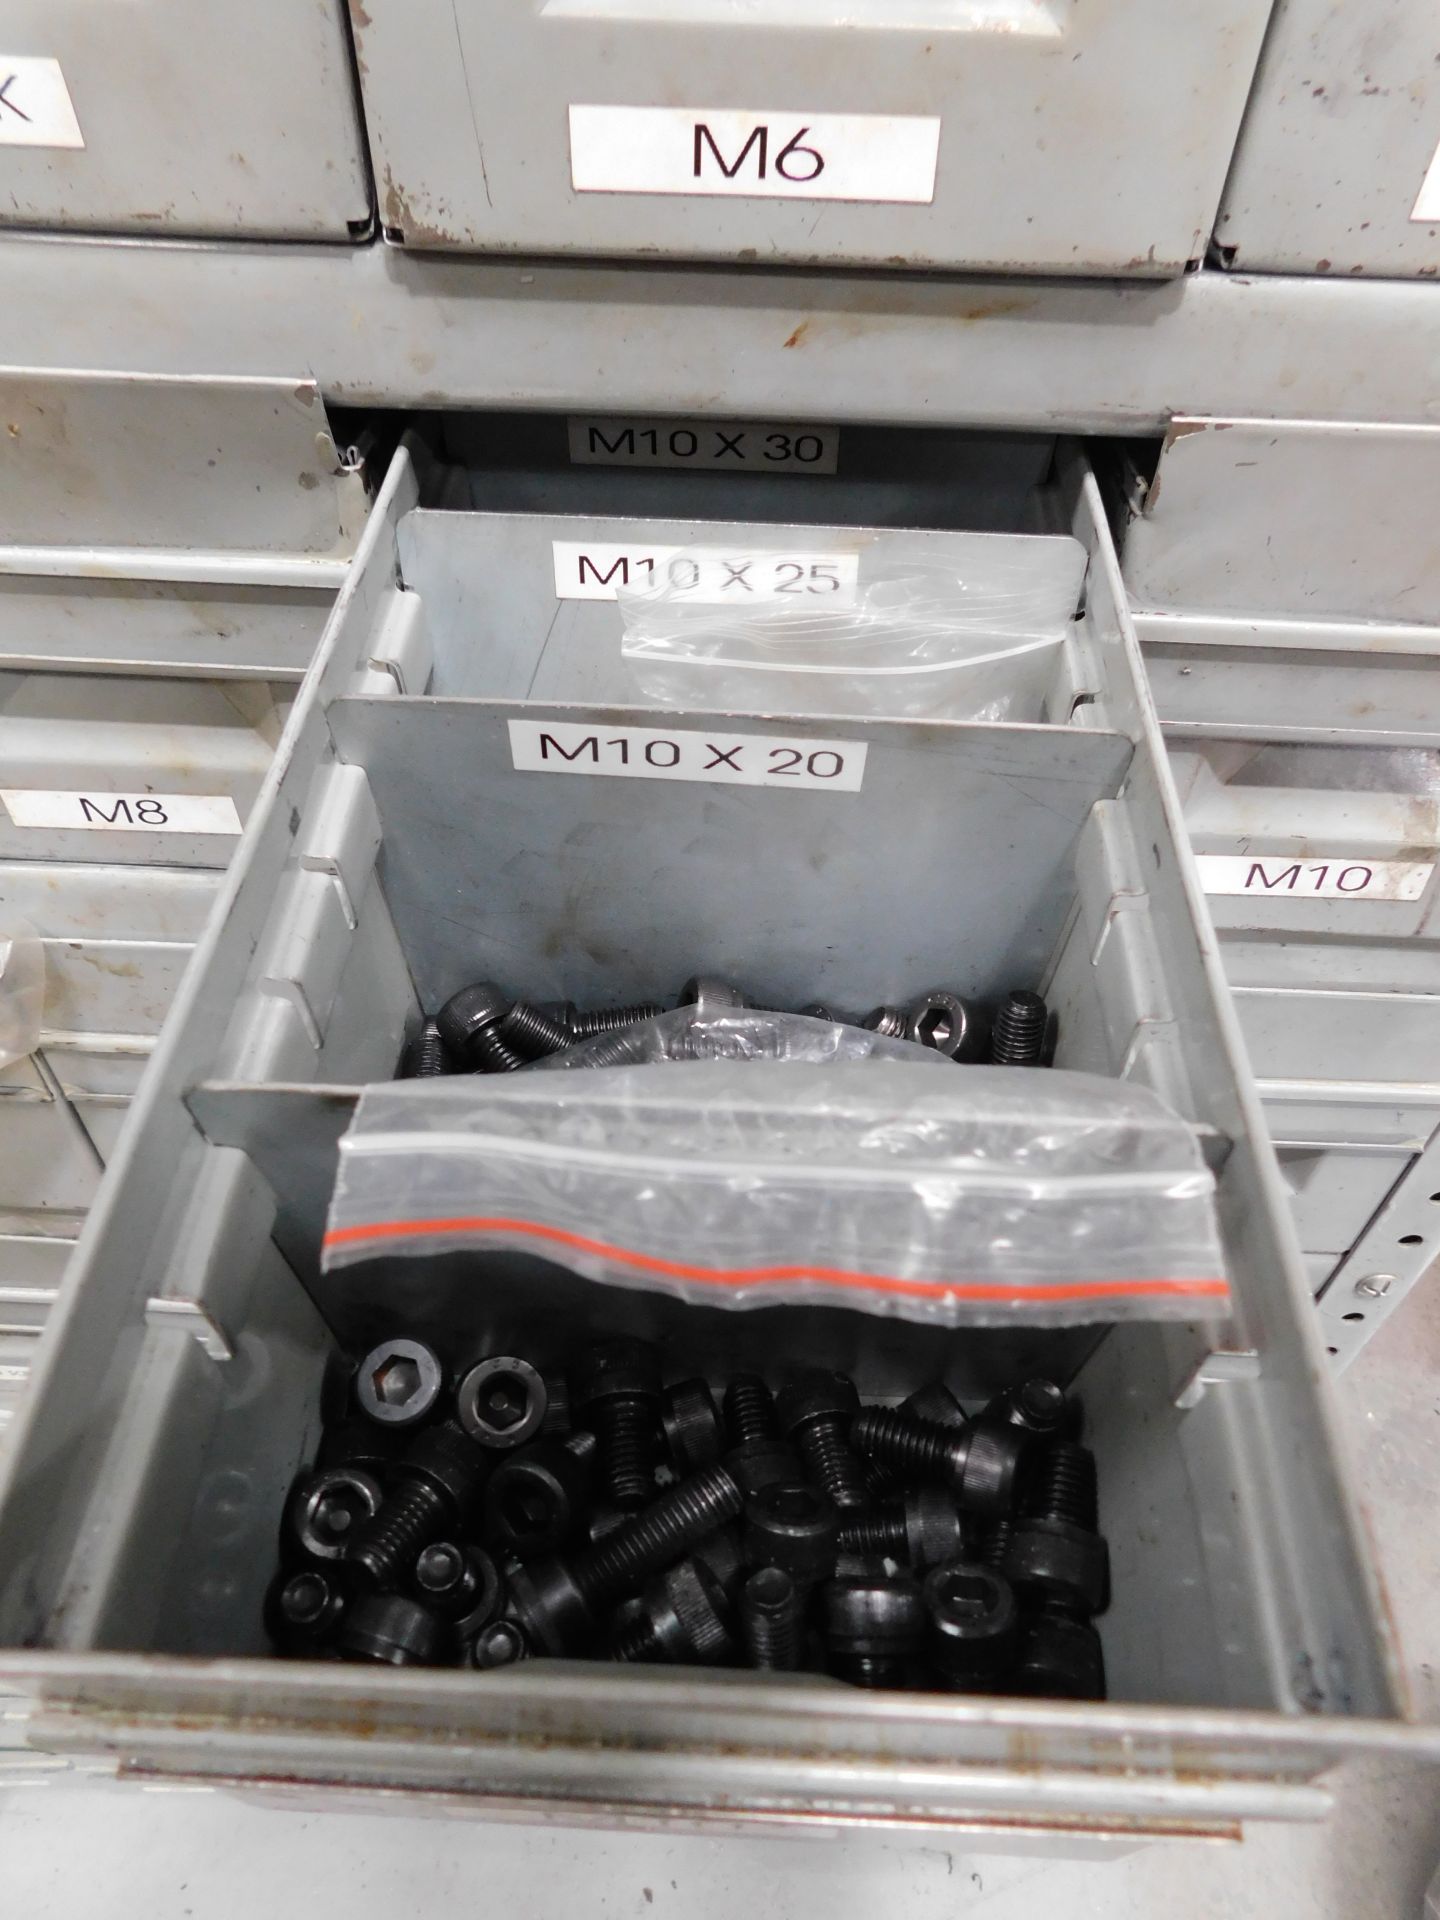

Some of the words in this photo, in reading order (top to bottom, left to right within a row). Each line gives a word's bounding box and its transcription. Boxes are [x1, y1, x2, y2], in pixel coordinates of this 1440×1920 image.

[694, 124, 824, 181] M6
[589, 427, 698, 457] M10
[714, 432, 746, 460] X
[764, 434, 823, 462] 30
[578, 555, 700, 588] M10
[720, 561, 754, 591] X
[774, 563, 839, 594] 25
[540, 733, 680, 767] M10
[703, 744, 744, 771] X
[767, 749, 844, 777] 20
[79, 798, 168, 824] M8
[1244, 863, 1372, 891] M10
